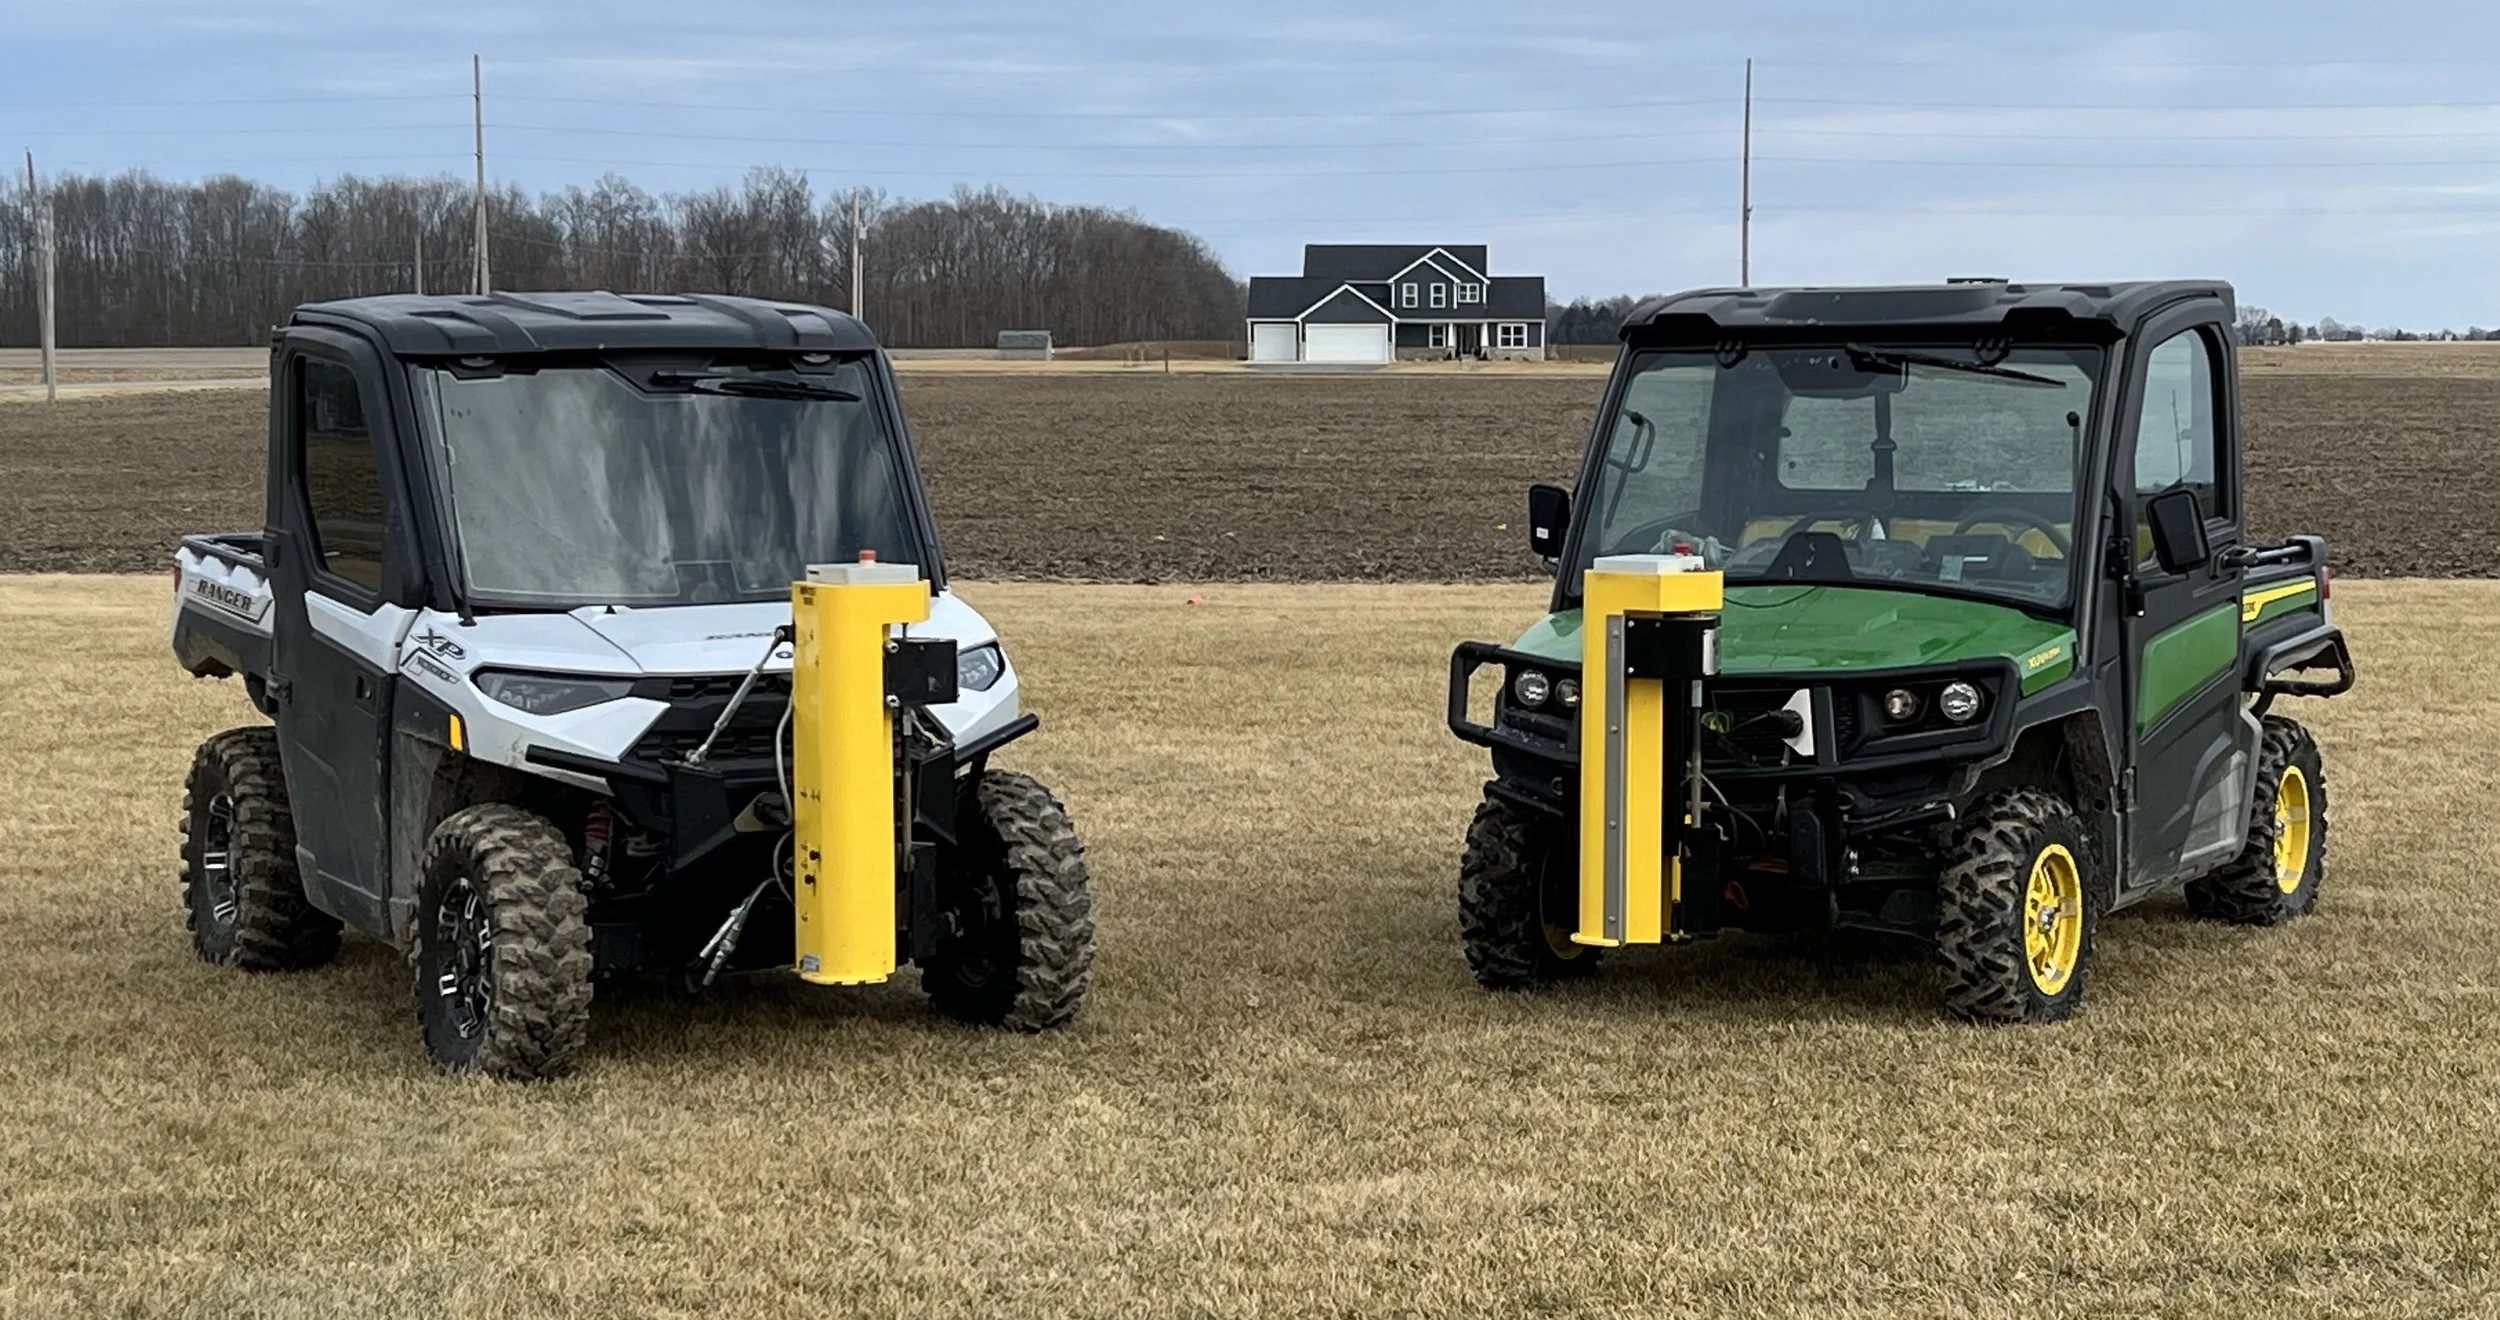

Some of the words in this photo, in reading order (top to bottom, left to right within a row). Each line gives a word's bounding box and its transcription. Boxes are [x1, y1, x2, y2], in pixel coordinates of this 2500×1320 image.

[197, 579, 252, 611] RANGER
[412, 627, 465, 659] XP
[416, 655, 450, 681] 1000
